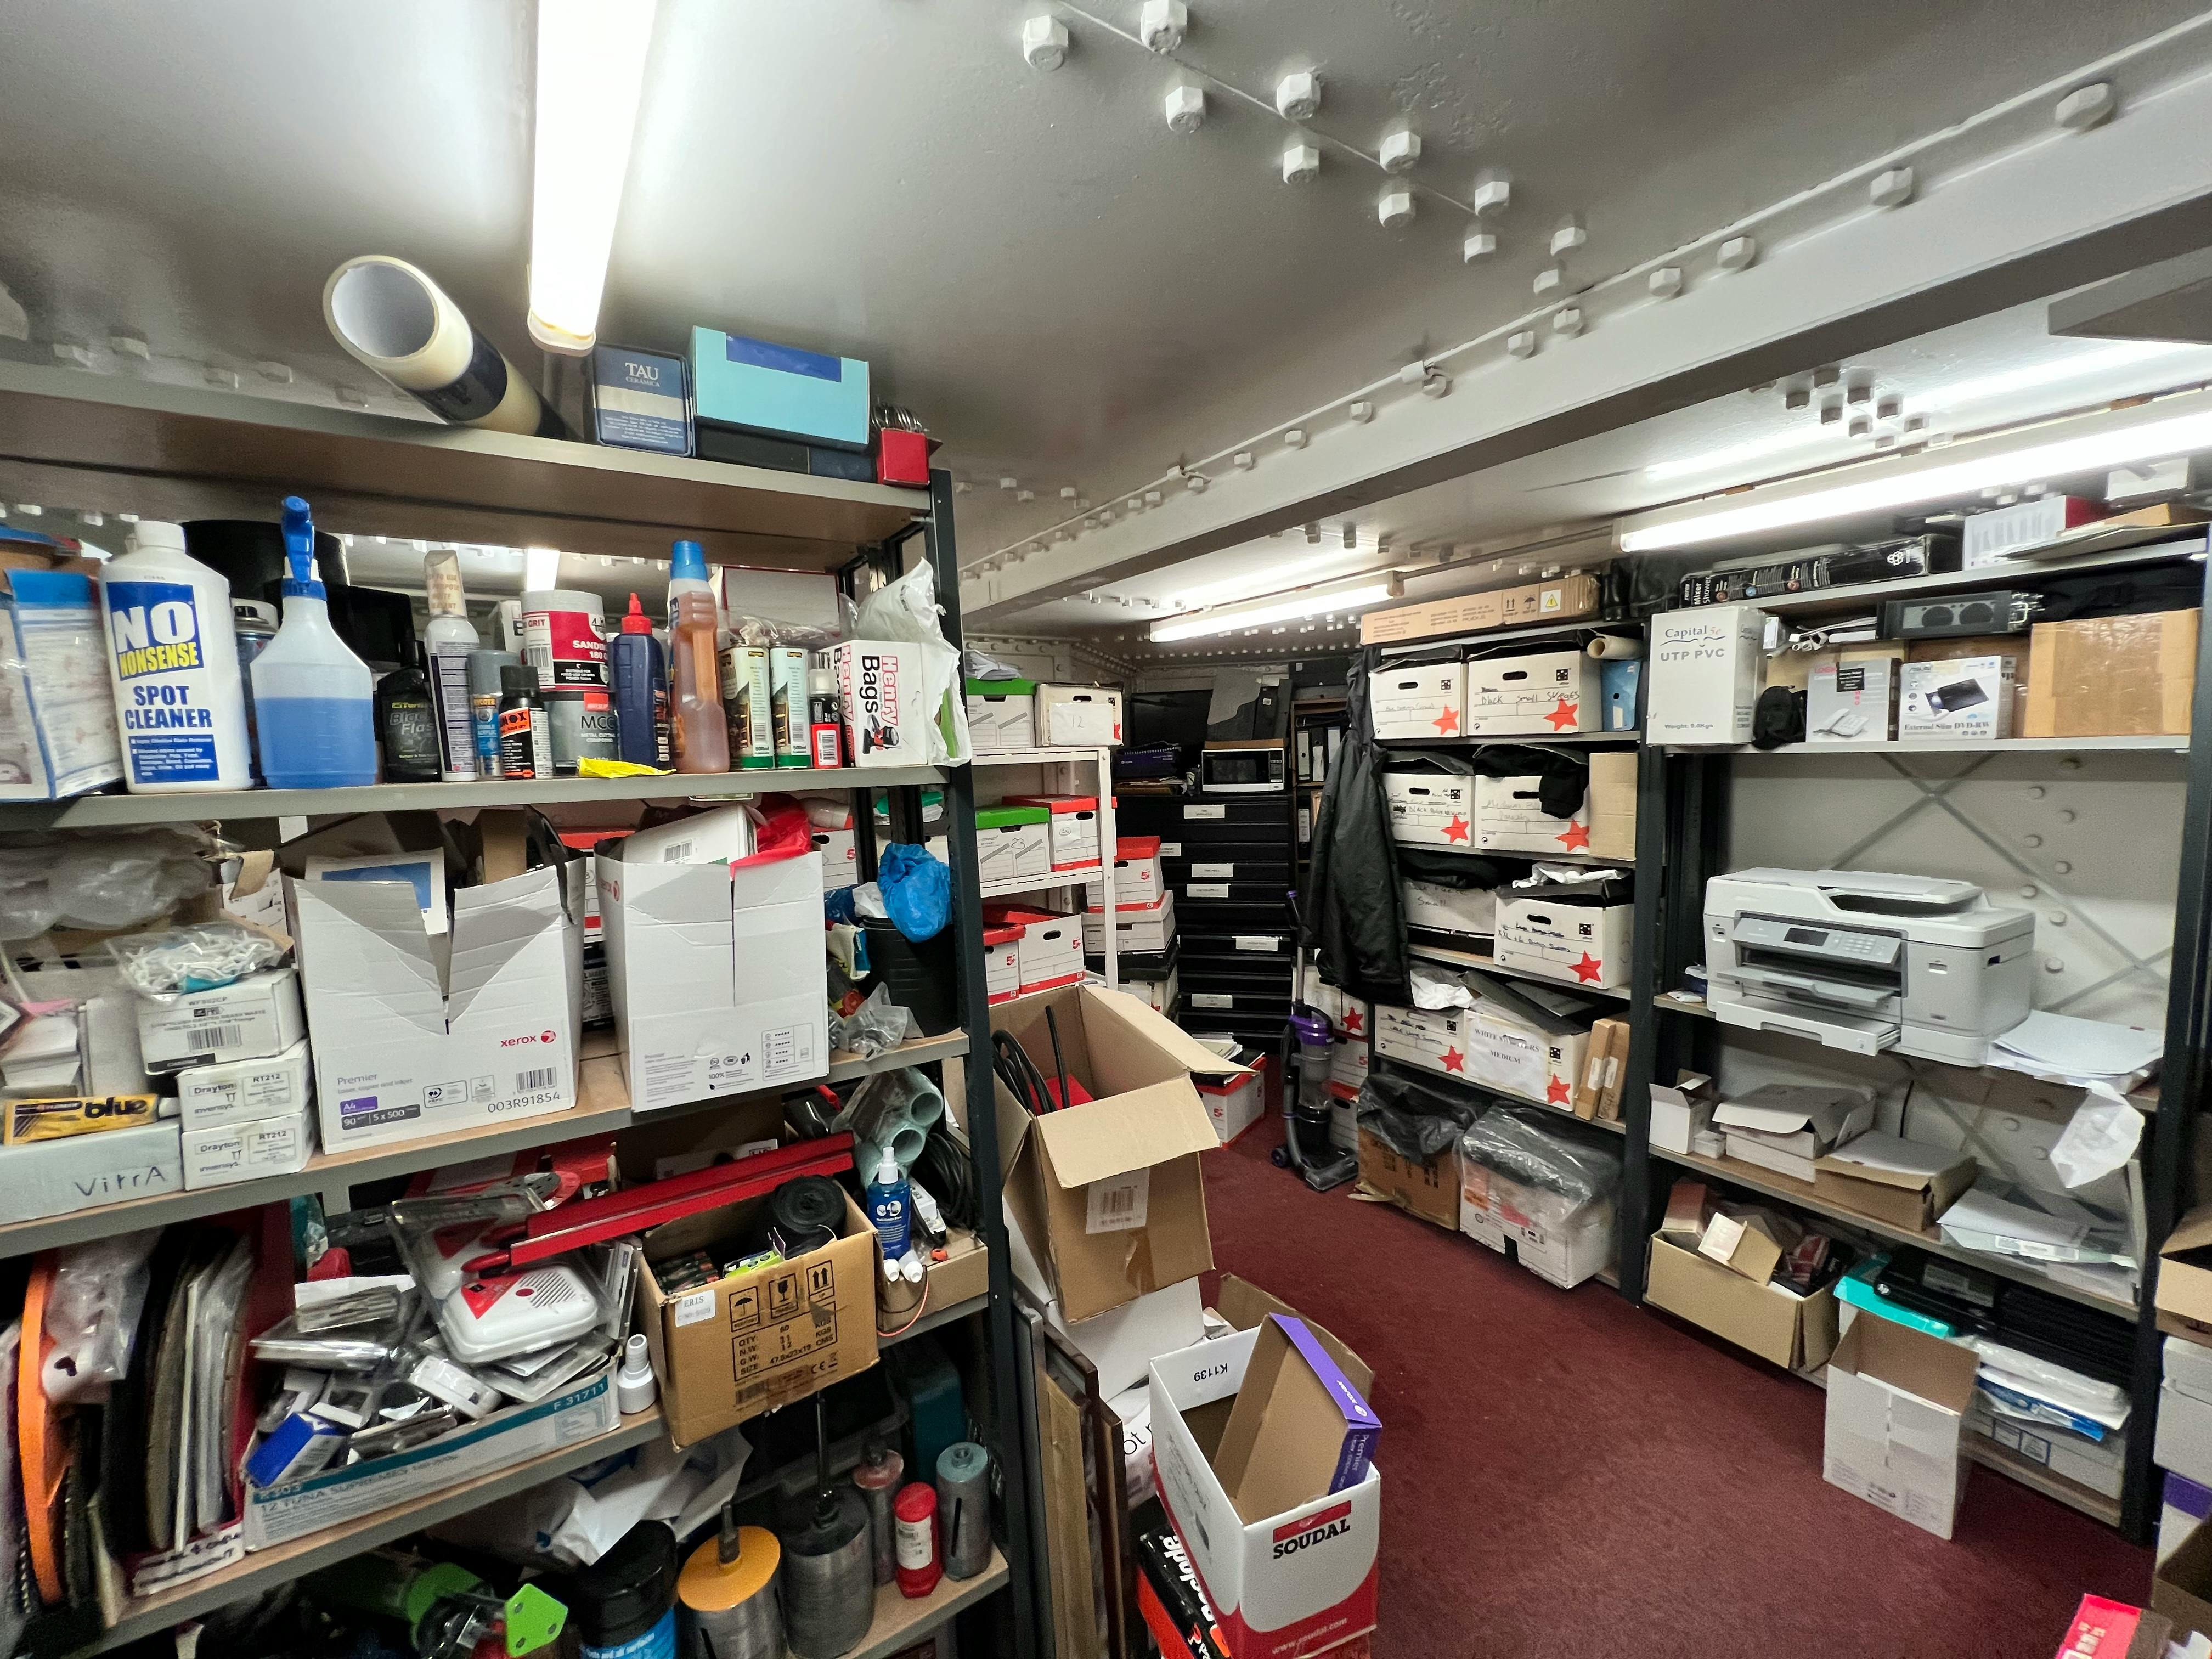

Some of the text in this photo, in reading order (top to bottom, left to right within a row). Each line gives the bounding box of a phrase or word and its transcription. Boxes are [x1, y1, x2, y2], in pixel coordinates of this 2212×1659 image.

[625, 362, 659, 380] TAU
[1702, 576, 1711, 605] Shower
[111, 601, 196, 653] NO
[1665, 625, 1707, 640] Capital
[119, 642, 199, 679] NONSENSE
[1661, 648, 1725, 662] UTP PVC
[842, 645, 854, 722] Henry
[859, 656, 880, 713] Bags
[133, 685, 189, 706] SPOT
[881, 656, 899, 726] Henry
[125, 709, 212, 729] CLEANER
[581, 716, 615, 730] MCC
[1073, 715, 1085, 729] 12
[1904, 723, 1934, 731] External
[500, 1035, 537, 1047] xerox
[1474, 1028, 1497, 1041] WHITE
[1490, 1049, 1521, 1065] MEDIUM
[253, 1073, 281, 1083] RT212
[337, 1073, 378, 1086] Premier
[194, 1083, 234, 1094] Drayton
[488, 1091, 560, 1113] 003R91854
[387, 1109, 405, 1119] 500
[343, 1117, 357, 1126] 90
[259, 1131, 287, 1141] RT212
[200, 1141, 241, 1153] Drayton
[684, 1295, 704, 1308] ERIS
[816, 1327, 832, 1337] KGS
[816, 1334, 833, 1346] CMS
[1193, 1362, 1228, 1382] K1139
[554, 1383, 605, 1410] F 31711
[1352, 1434, 1369, 1471] Premier
[1272, 1518, 1351, 1560] SOUDAL
